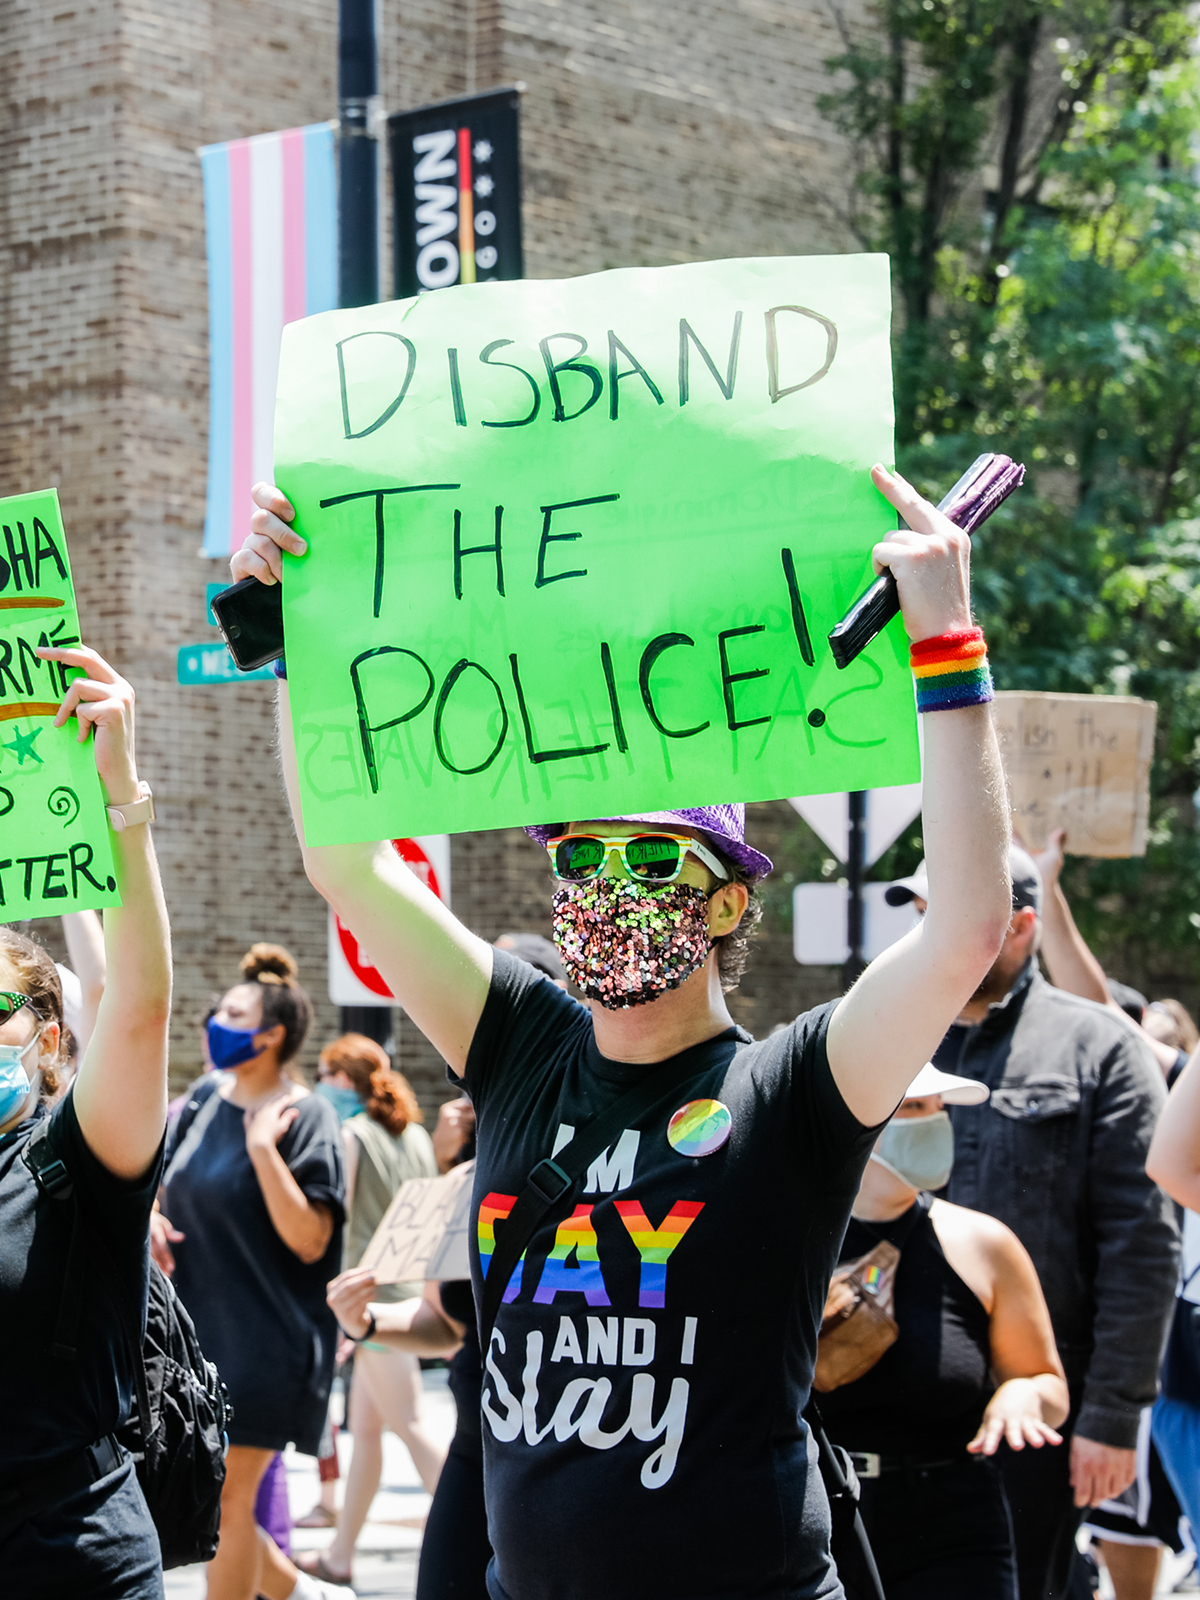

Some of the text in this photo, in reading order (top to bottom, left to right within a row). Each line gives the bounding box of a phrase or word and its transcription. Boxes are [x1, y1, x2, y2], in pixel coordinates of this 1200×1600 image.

[412, 128, 459, 293] OWN
[335, 304, 839, 440] DISBAND
[319, 483, 621, 619] THE
[350, 547, 828, 794] POLICE!
[481, 1326, 690, 1490] Slay
[550, 1315, 698, 1366] AND I
